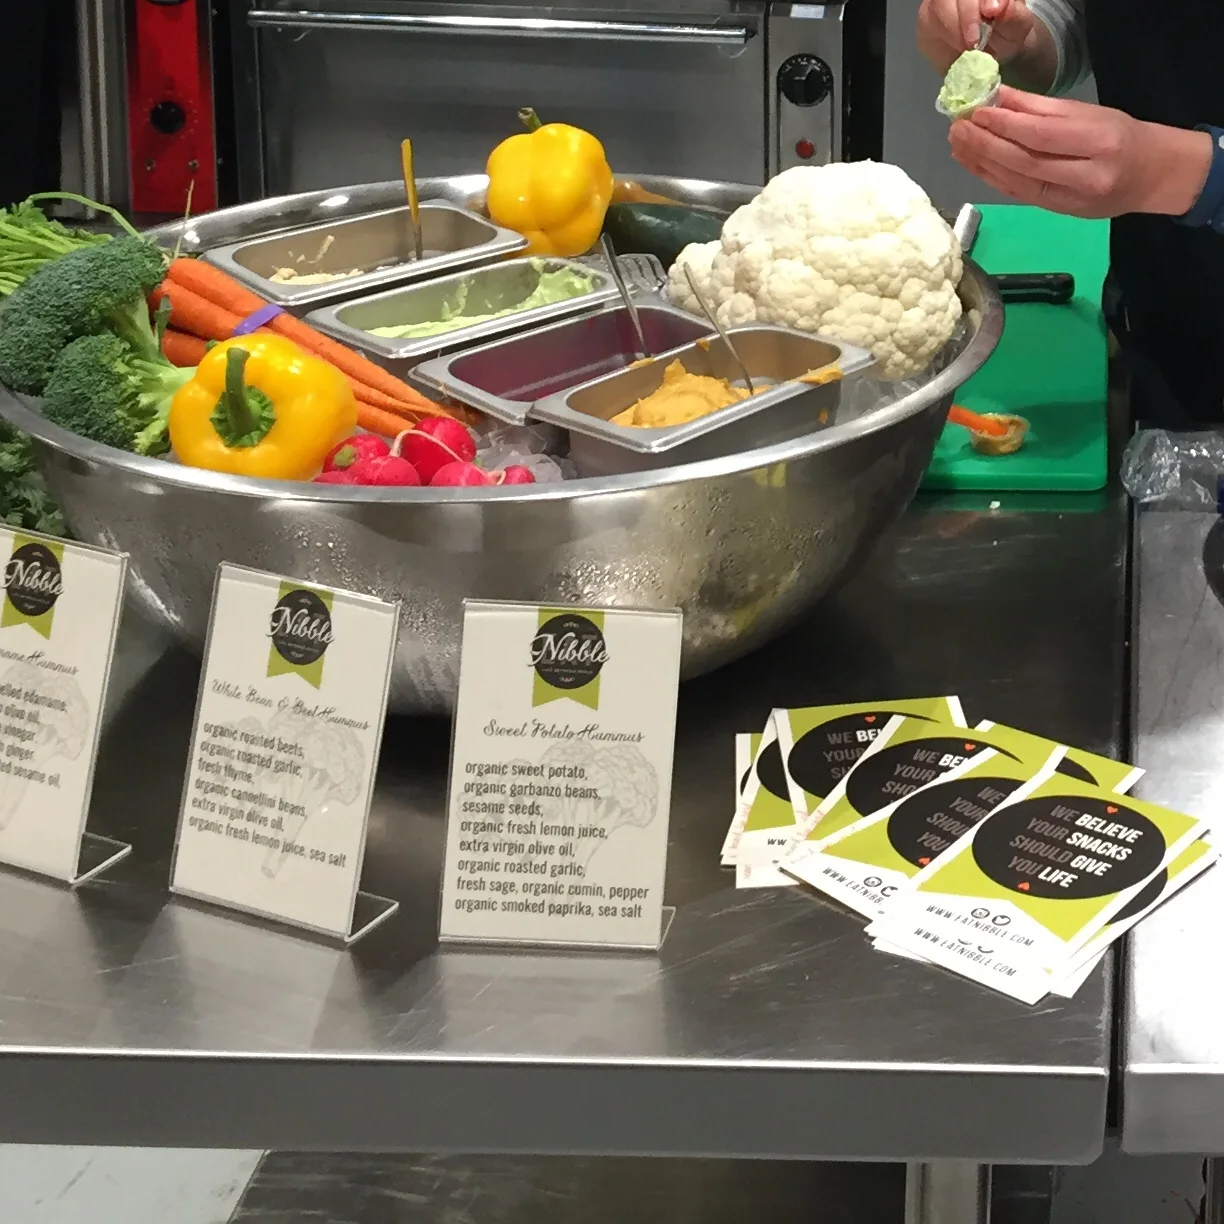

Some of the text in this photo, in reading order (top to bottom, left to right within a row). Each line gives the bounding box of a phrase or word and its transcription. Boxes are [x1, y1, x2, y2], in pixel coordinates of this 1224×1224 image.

[0, 559, 64, 595] Nibble
[265, 606, 335, 644] Nibble
[527, 632, 610, 667] Nibble
[211, 679, 241, 700] White
[245, 685, 273, 708] Bean
[292, 697, 318, 717] Beet
[316, 707, 371, 730] Hummus
[203, 722, 305, 758] organic roasted beets,
[483, 718, 645, 743] Sweet Potato Hummus
[826, 731, 853, 745] WE
[200, 740, 302, 778] organic roasted garlic,
[912, 748, 940, 764] WE
[197, 757, 254, 785] fresh thyme,
[465, 762, 588, 780] organic sweet potato,
[893, 763, 936, 782] YOUR
[195, 778, 308, 820] organic cannellini beans,
[464, 782, 601, 800] organic garbanzo beans,
[881, 780, 918, 796] SHO
[976, 786, 1007, 805] WE
[192, 797, 284, 832] extra virgin olive oil,
[462, 801, 544, 817] sesame seeds,
[948, 796, 989, 822] YOUR
[460, 820, 608, 839] organic fresh lemon juice,
[926, 812, 970, 838] SHOU
[1050, 804, 1144, 843] WE BELIEVE
[189, 815, 347, 868] organic fresh lemon juice, sea salt
[459, 839, 576, 857] extra virgin olive oil,
[916, 831, 951, 852] YOU
[1026, 817, 1133, 861] YOUR SNACKS
[457, 859, 586, 878] organic roasted garlic,
[1009, 834, 1113, 877] SHOULD GIVE
[1007, 856, 1079, 888] YOU LIFE
[456, 876, 649, 901] fresh sage, organic cumin, pepper
[454, 897, 642, 918] organic smoked paprika, sea salt
